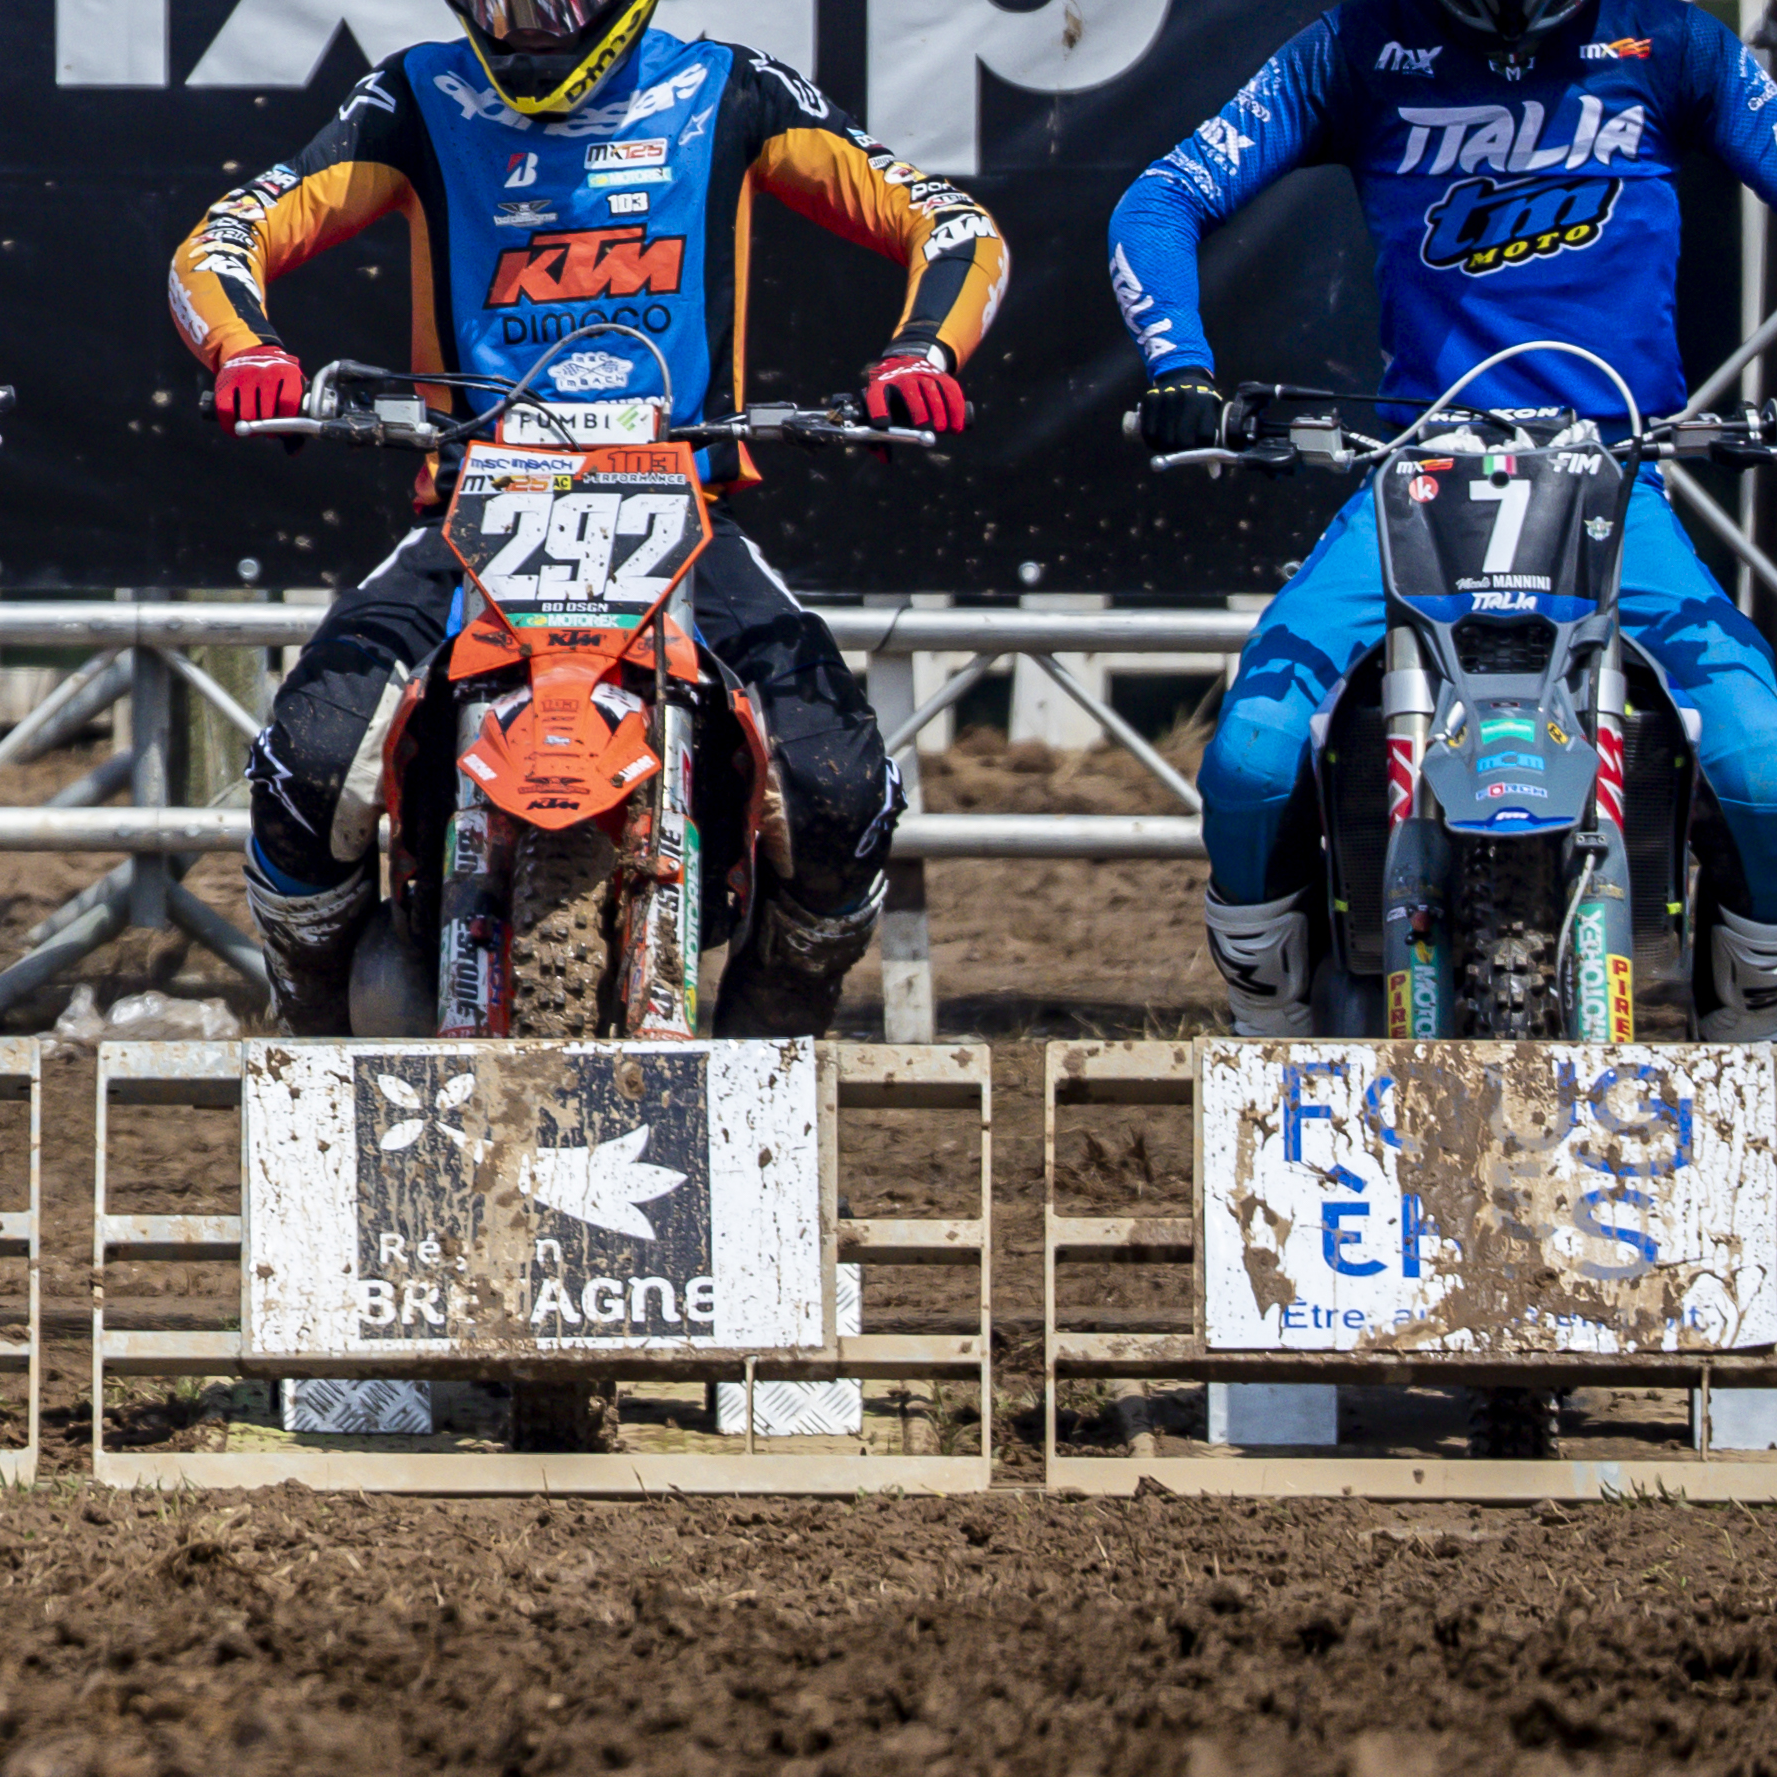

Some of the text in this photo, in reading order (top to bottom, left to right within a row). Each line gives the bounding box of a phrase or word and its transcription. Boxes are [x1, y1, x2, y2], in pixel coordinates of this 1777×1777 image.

[1397, 93, 1645, 175] ITALIA
[608, 193, 648, 213] 103
[923, 212, 998, 261] KTM
[1468, 223, 1592, 270] MOTO
[487, 226, 684, 307] KTM
[502, 304, 673, 346] DIMOCO
[519, 413, 612, 431] FUMBI
[607, 451, 679, 475] 103
[583, 472, 687, 485] PERFORMANCE
[1469, 480, 1531, 574] 7
[477, 492, 691, 602] 292
[1493, 573, 1551, 592] MANNINI
[566, 602, 608, 613] DSGN
[1469, 592, 1538, 611] ITALIA
[547, 613, 619, 628] MOTOREX
[546, 630, 607, 648] KTM
[525, 797, 580, 811] KTM
